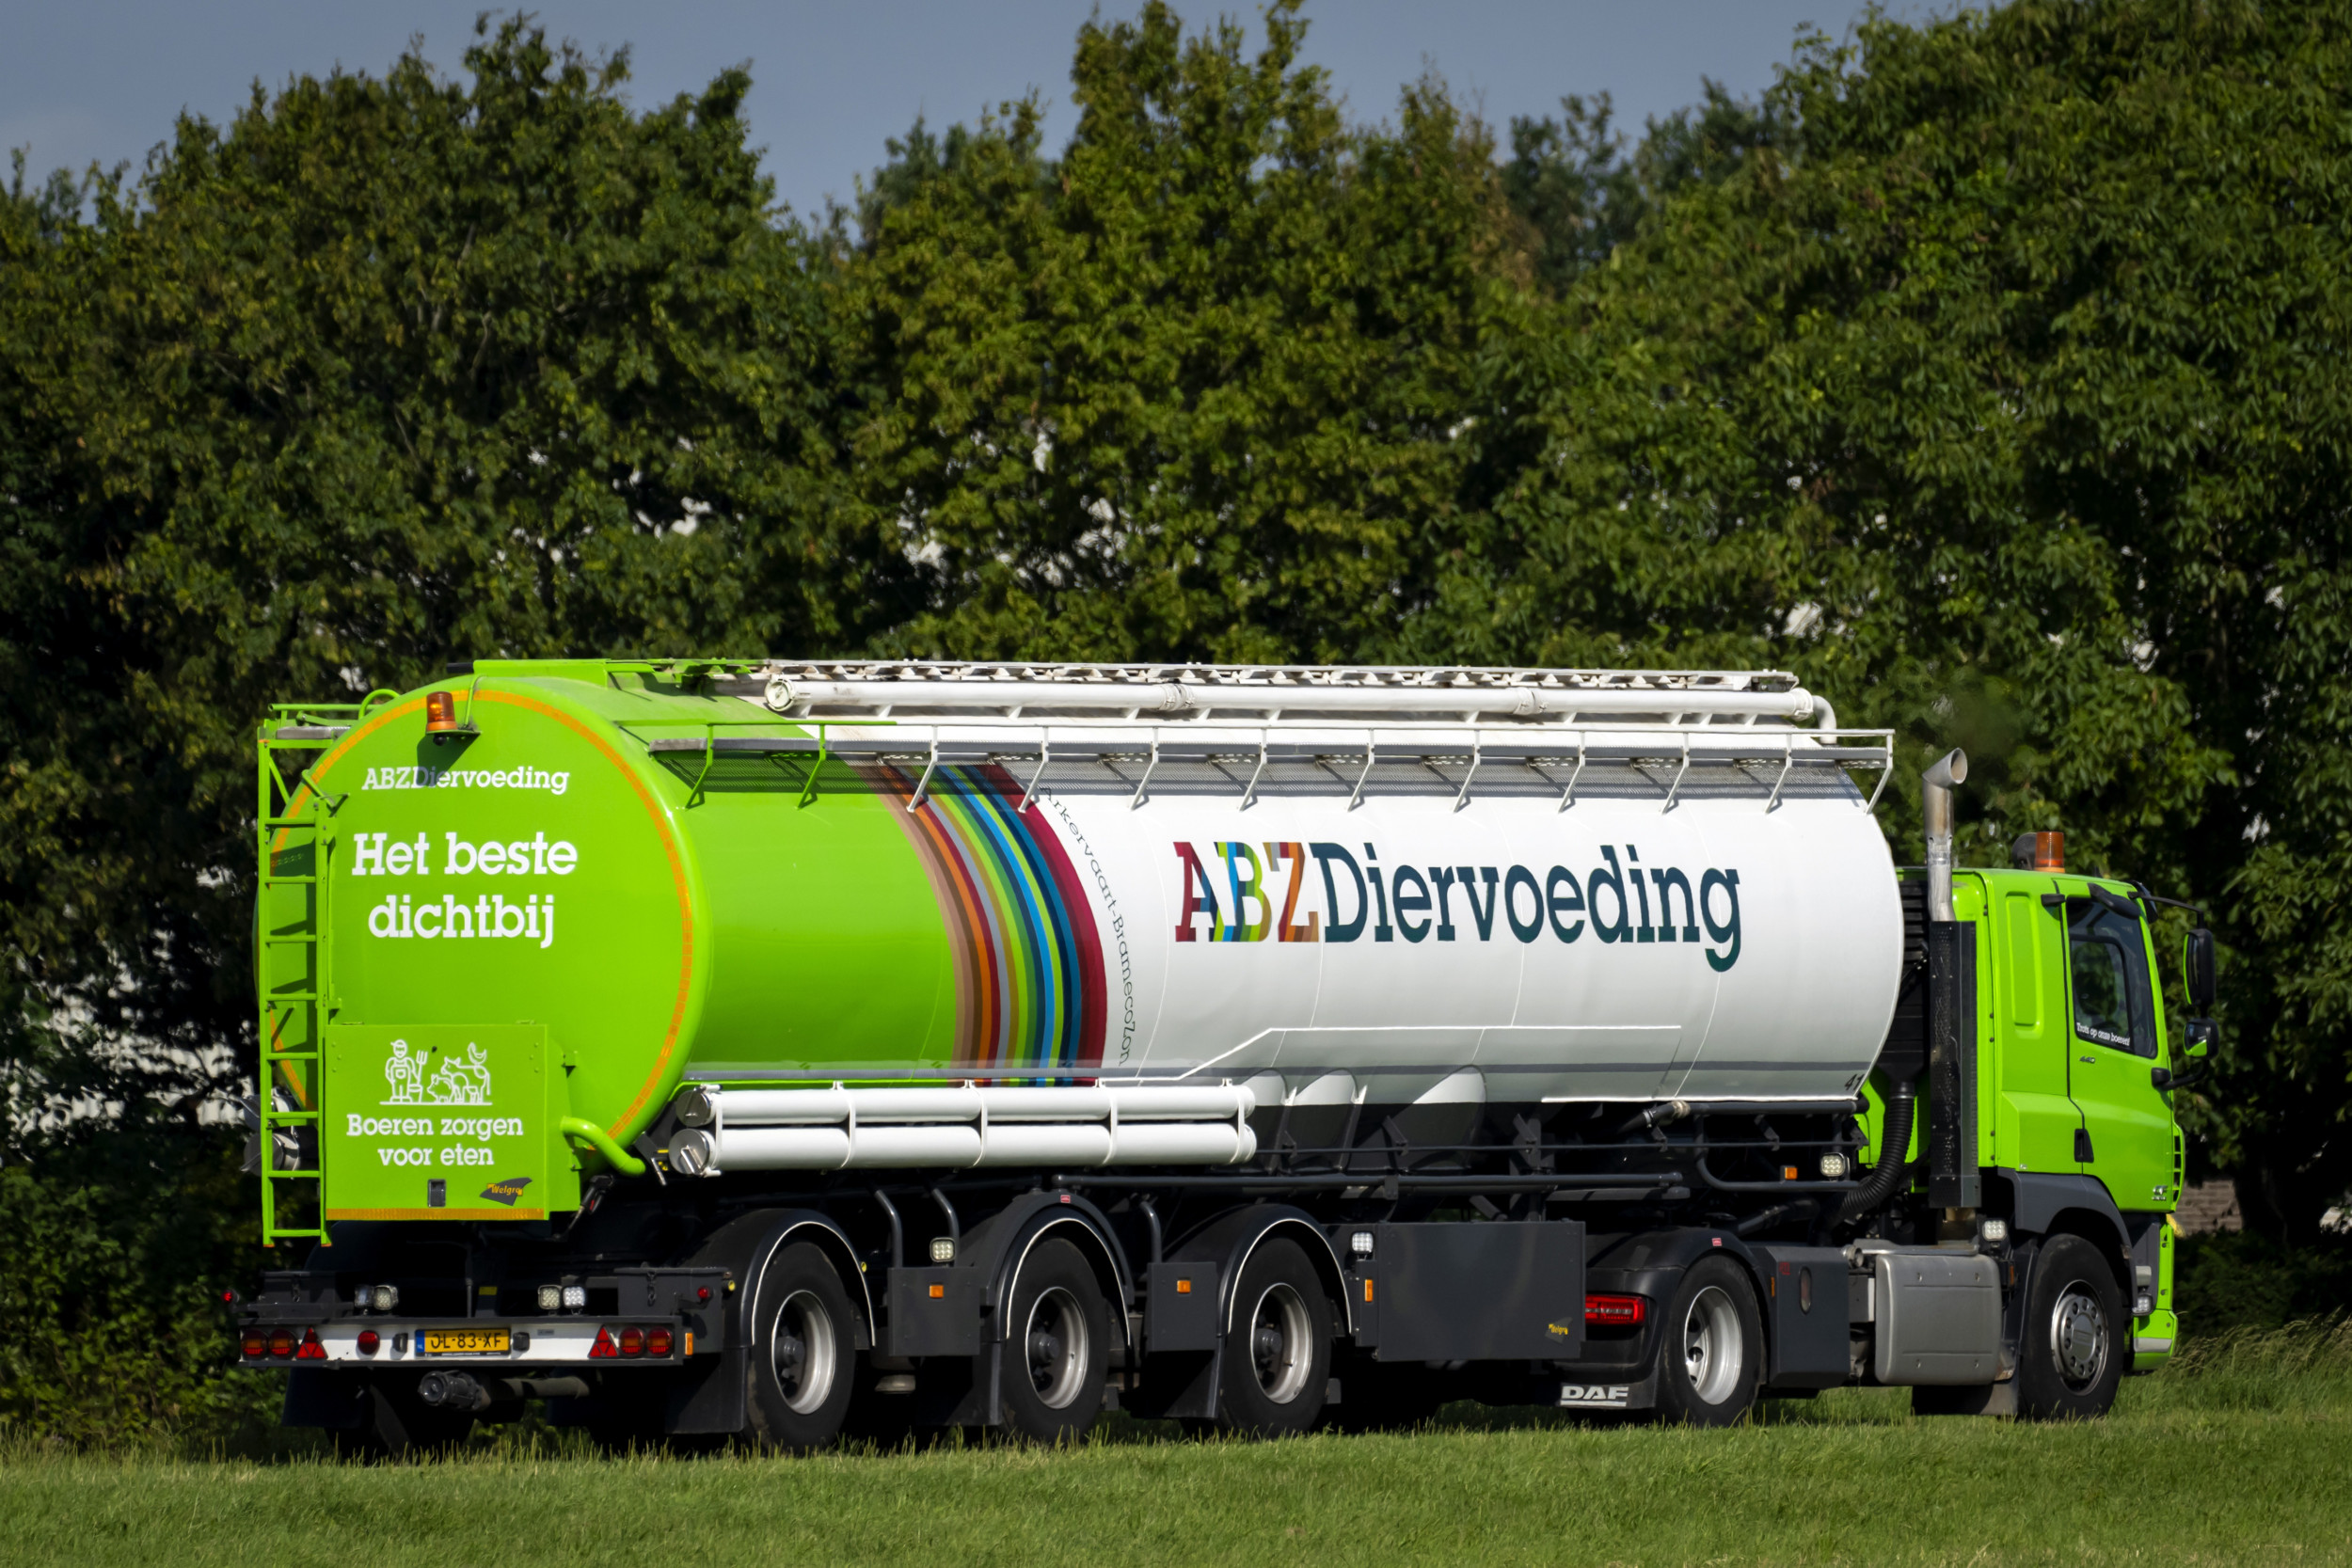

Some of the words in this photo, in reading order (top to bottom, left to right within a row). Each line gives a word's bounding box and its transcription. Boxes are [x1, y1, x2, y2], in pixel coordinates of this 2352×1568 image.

[361, 766, 570, 795] ABZDiervoeding
[352, 832, 430, 876] Het
[444, 832, 578, 876] beste
[368, 894, 554, 949] dichtbij
[1173, 841, 1741, 973] ABZDiervoeding
[346, 1114, 435, 1136] Boeren
[440, 1117, 524, 1141] zorgen
[377, 1147, 433, 1166] voor
[439, 1143, 495, 1166] eten
[1561, 1386, 1629, 1401] DAF
